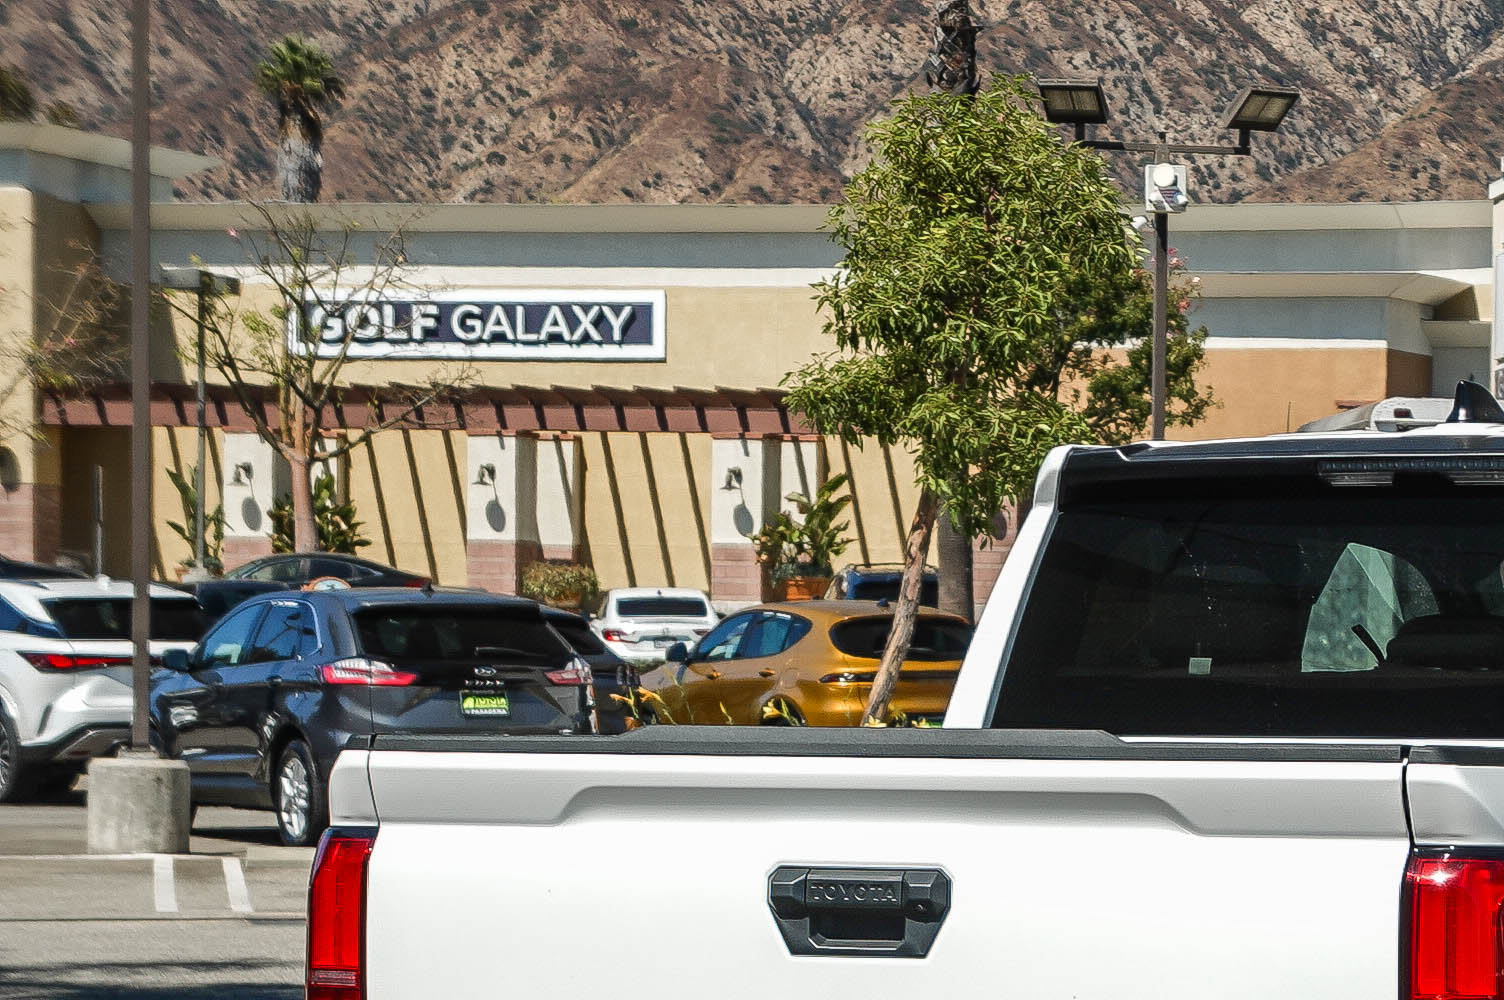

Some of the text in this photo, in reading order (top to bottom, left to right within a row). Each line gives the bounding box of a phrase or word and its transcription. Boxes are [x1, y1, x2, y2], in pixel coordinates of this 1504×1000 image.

[311, 302, 633, 343] GOLF GALAXY
[811, 884, 898, 902] TOYOTA
